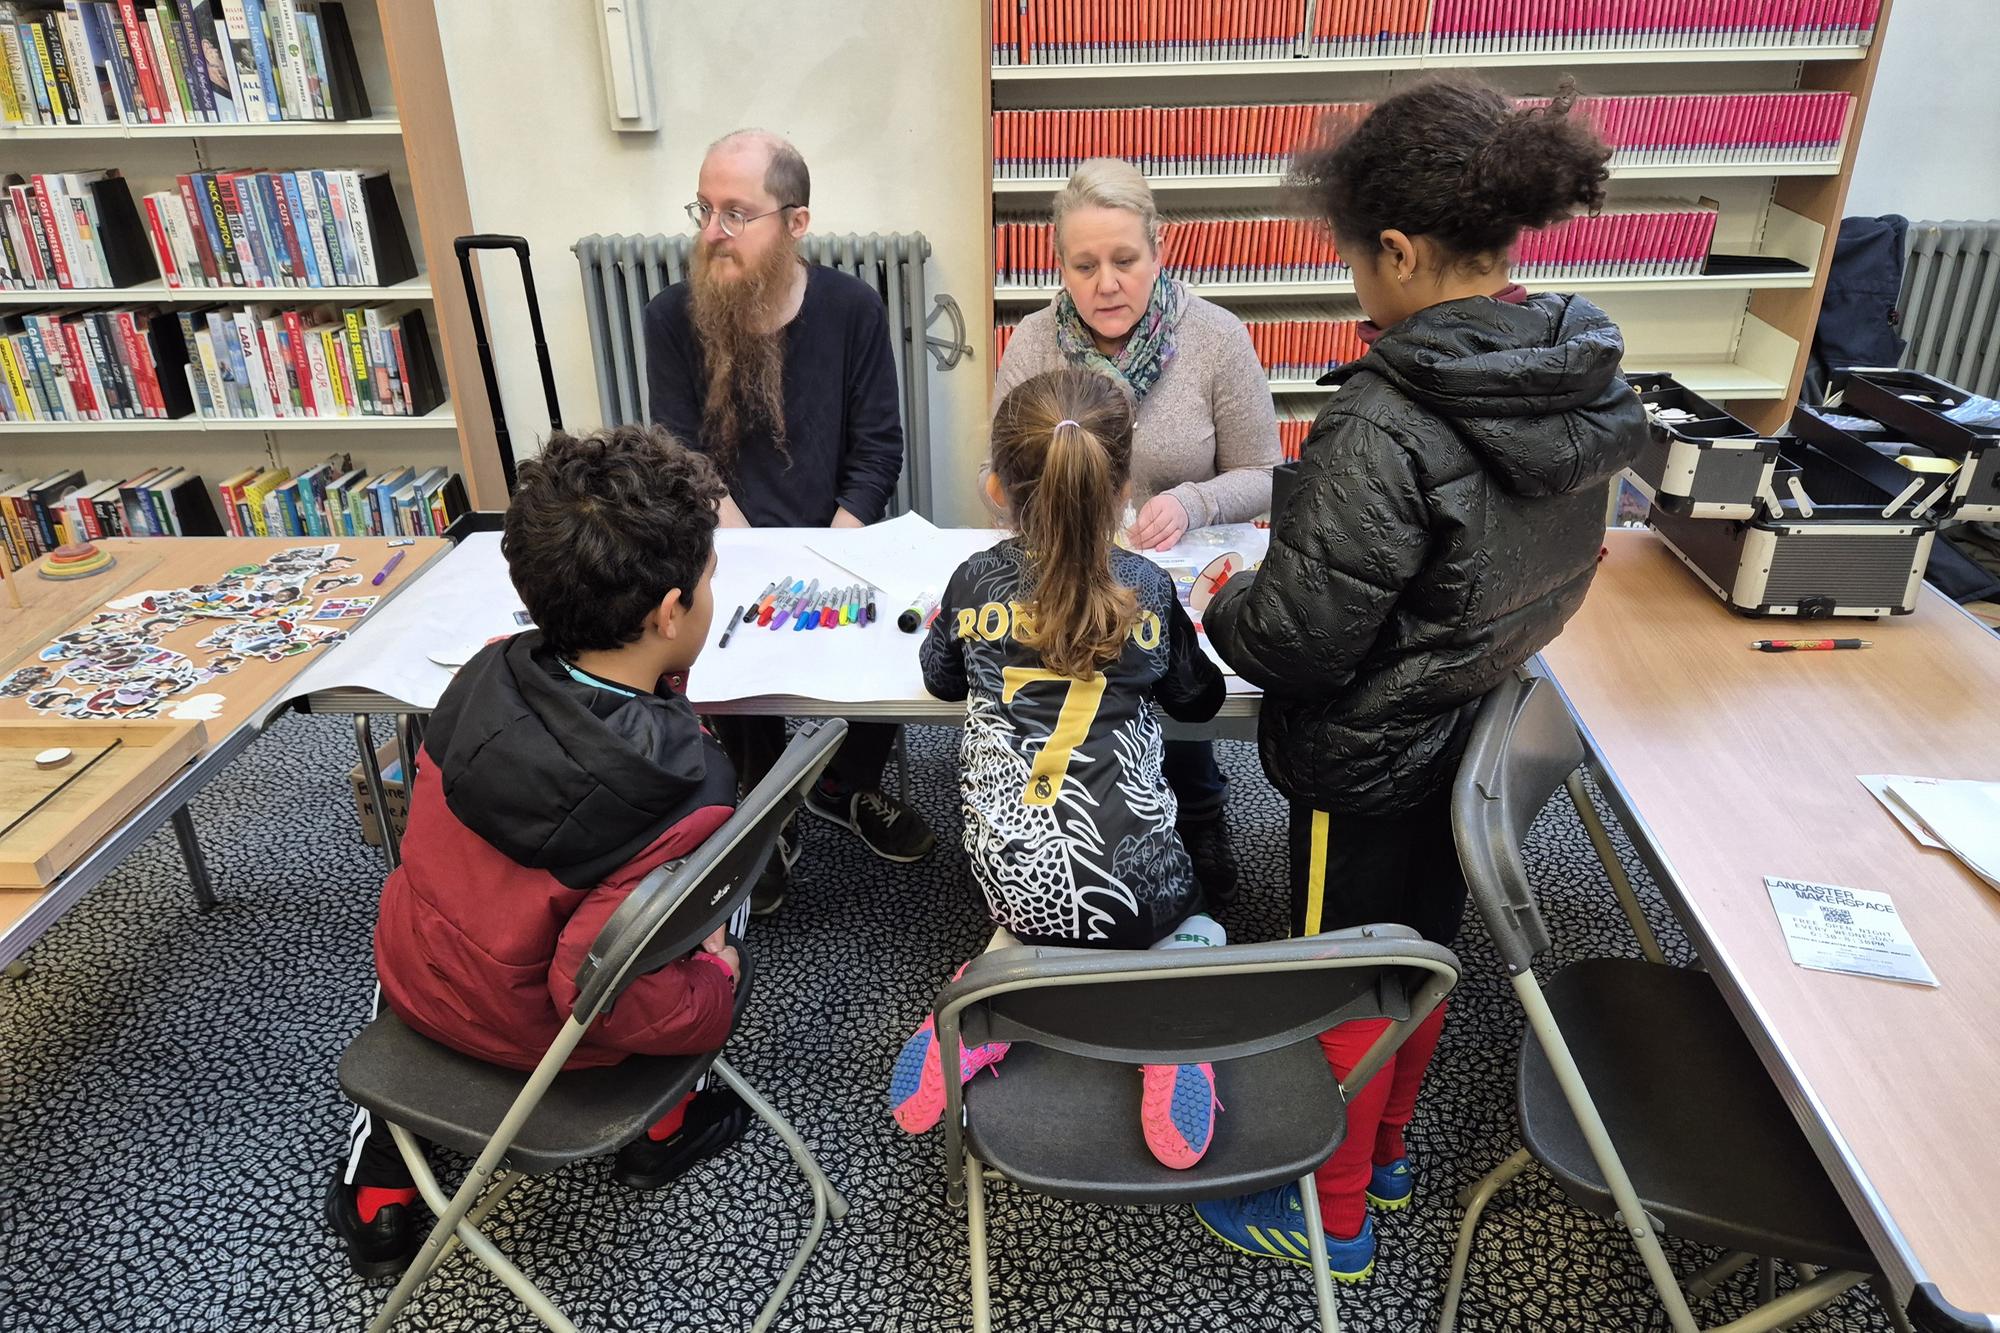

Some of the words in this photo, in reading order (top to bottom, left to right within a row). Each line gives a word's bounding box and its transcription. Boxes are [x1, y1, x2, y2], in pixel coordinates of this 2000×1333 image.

[123, 4, 135, 29] Dear
[130, 30, 146, 70] England
[185, 21, 197, 54] BARKER
[246, 4, 256, 24] Sue
[251, 26, 264, 59] Barker
[220, 180, 232, 197] TWO
[273, 180, 283, 200] LATE
[279, 203, 290, 226] CUTS
[299, 174, 313, 210] KEVIN
[39, 197, 48, 217] LOST
[46, 219, 61, 263] LIONESSES
[208, 180, 218, 202] NICK
[215, 204, 231, 248] COMPTON
[225, 199, 243, 240] BROTHERS
[243, 200, 255, 231] DEXTER
[348, 190, 357, 214] JUDGE
[355, 221, 364, 243] ROBIN
[320, 197, 330, 223] KEVIN
[327, 224, 342, 271] PIETERSEN
[29, 327, 43, 359] GAME
[86, 318, 96, 337] MIND
[92, 338, 104, 363] GAMES
[121, 317, 131, 336] Clive
[182, 318, 193, 339] BEN
[239, 326, 251, 358] LARA
[347, 313, 359, 343] CASTER
[22, 344, 34, 370] GAME
[312, 355, 326, 388] TOUR
[352, 344, 366, 380] SEMENYA
[957, 601, 1161, 650] RONO
[1002, 666, 1107, 807] 7
[1766, 879, 1854, 899] LANCASTER
[1795, 891, 1895, 914] MAKERSPACE
